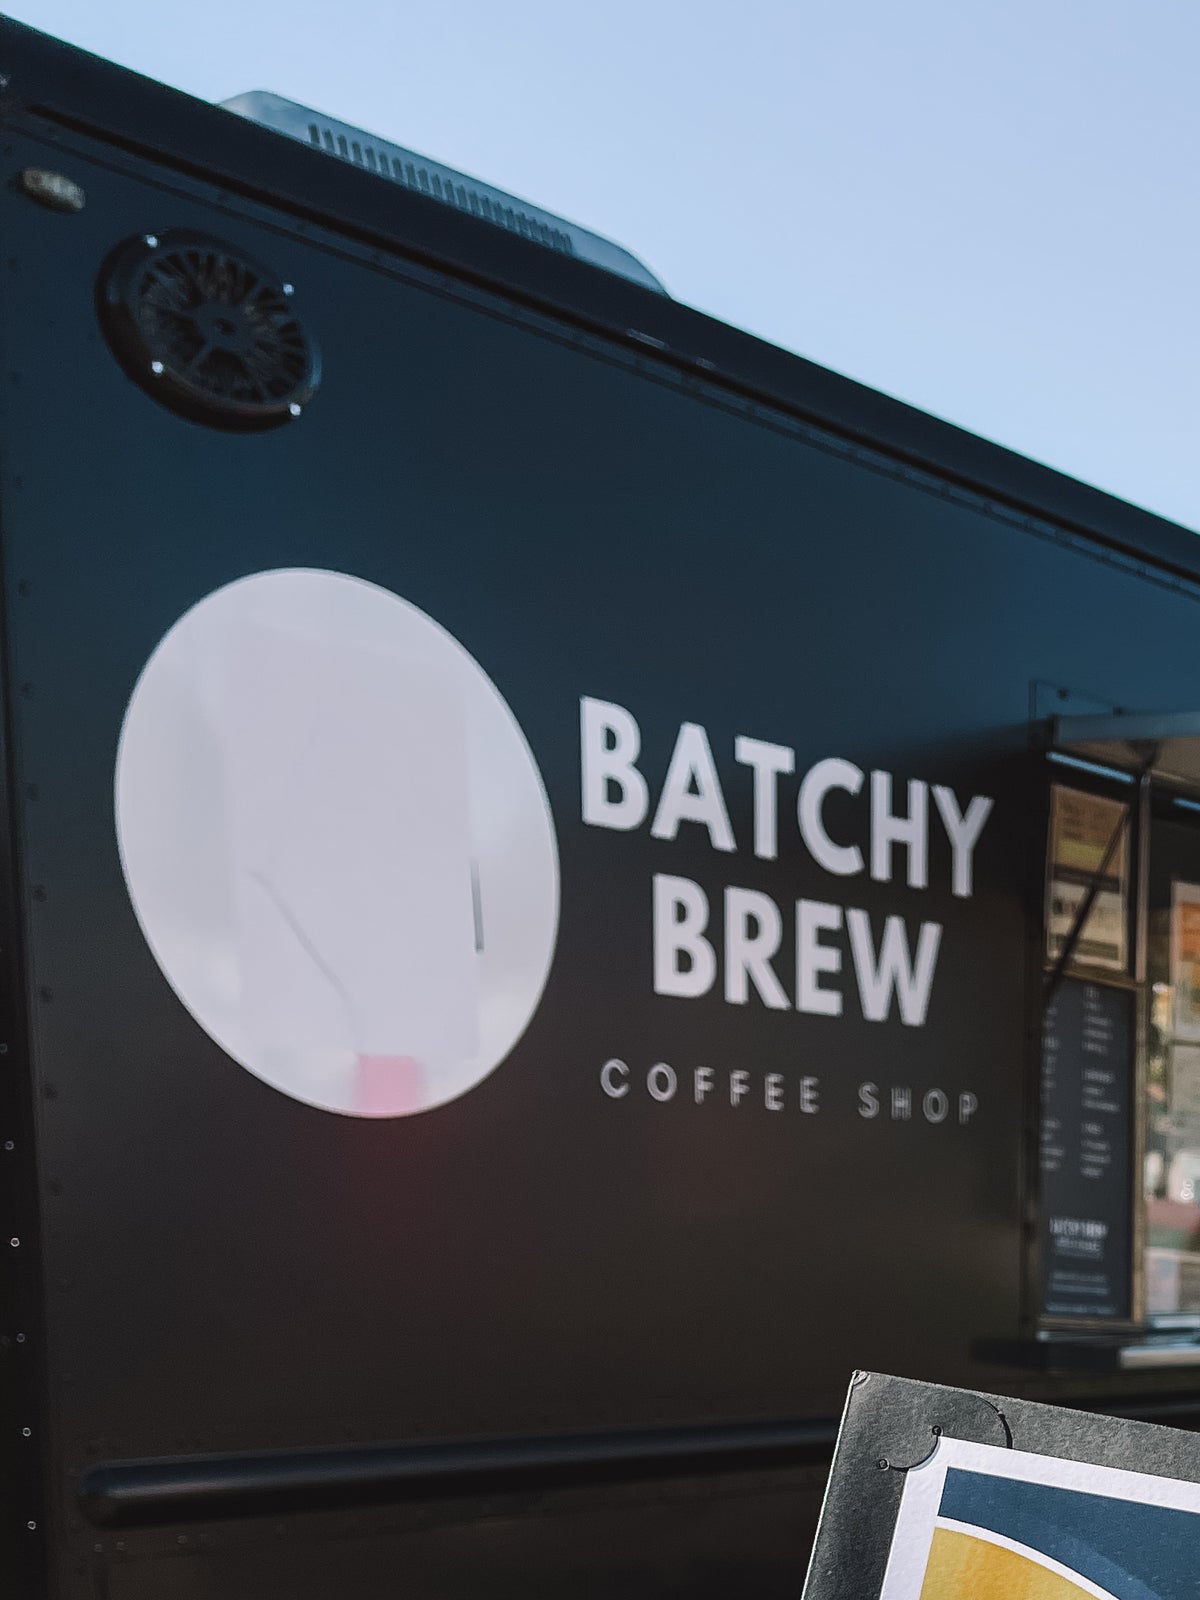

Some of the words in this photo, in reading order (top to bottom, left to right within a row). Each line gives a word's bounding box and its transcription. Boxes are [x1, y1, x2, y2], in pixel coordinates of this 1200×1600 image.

[580, 694, 995, 898] BATCHY
[652, 872, 943, 1027] BREW
[600, 1057, 821, 1115] COFFEE
[857, 1081, 979, 1125] SHOP
